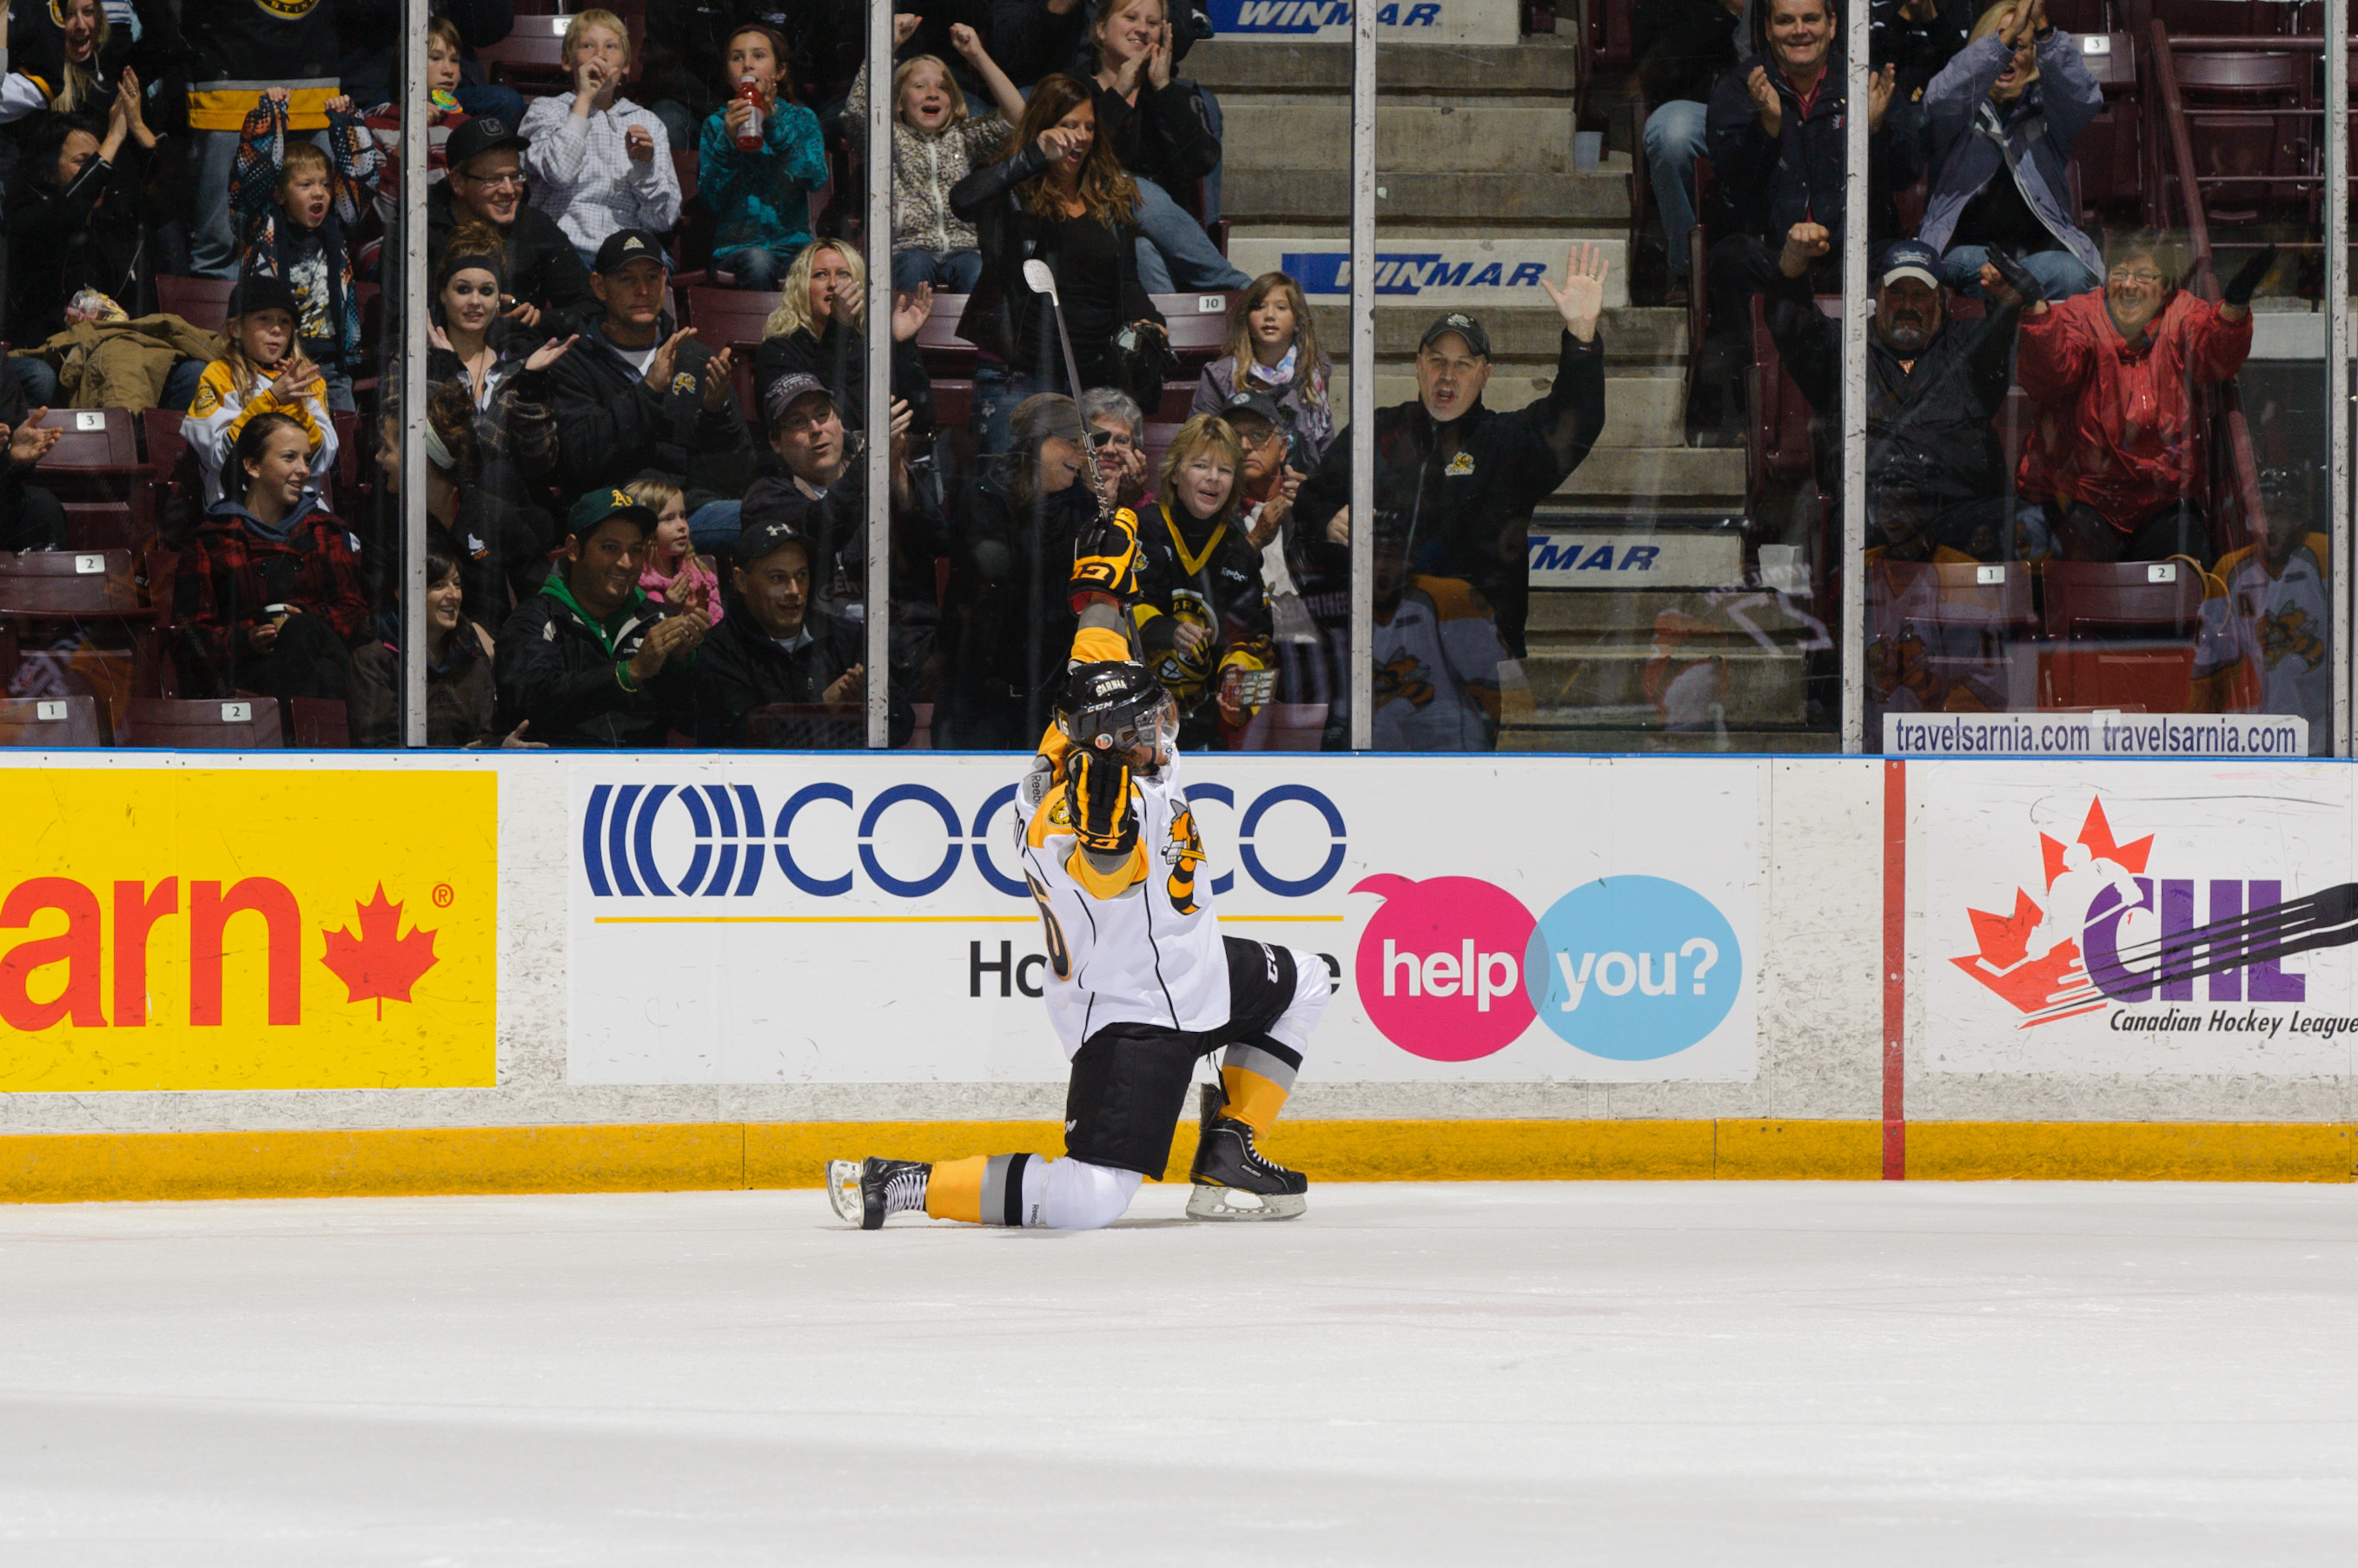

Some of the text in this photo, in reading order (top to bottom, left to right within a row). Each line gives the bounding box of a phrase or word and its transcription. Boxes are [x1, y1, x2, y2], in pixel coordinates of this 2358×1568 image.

[1205, 298, 1219, 308] 10
[87, 415, 95, 426] 3
[86, 559, 95, 569] 2
[1530, 545, 1660, 571] MAR
[1989, 570, 1994, 579] 1
[2158, 568, 2166, 578] 2
[1096, 678, 1128, 697] SARNIA
[48, 705, 55, 715] 1
[232, 706, 241, 717] 2
[1087, 700, 1113, 712] CCM
[1896, 717, 2296, 753] travelsarnia.com travelsarnia.com
[1031, 775, 1042, 805] Reeb
[2083, 877, 2306, 1002] CHL
[0, 876, 301, 1031] arn
[970, 940, 1045, 998] Ho
[1382, 938, 1519, 1012] help
[1555, 937, 1719, 1012] you?
[2110, 1008, 2358, 1040] Canadian Hockey League
